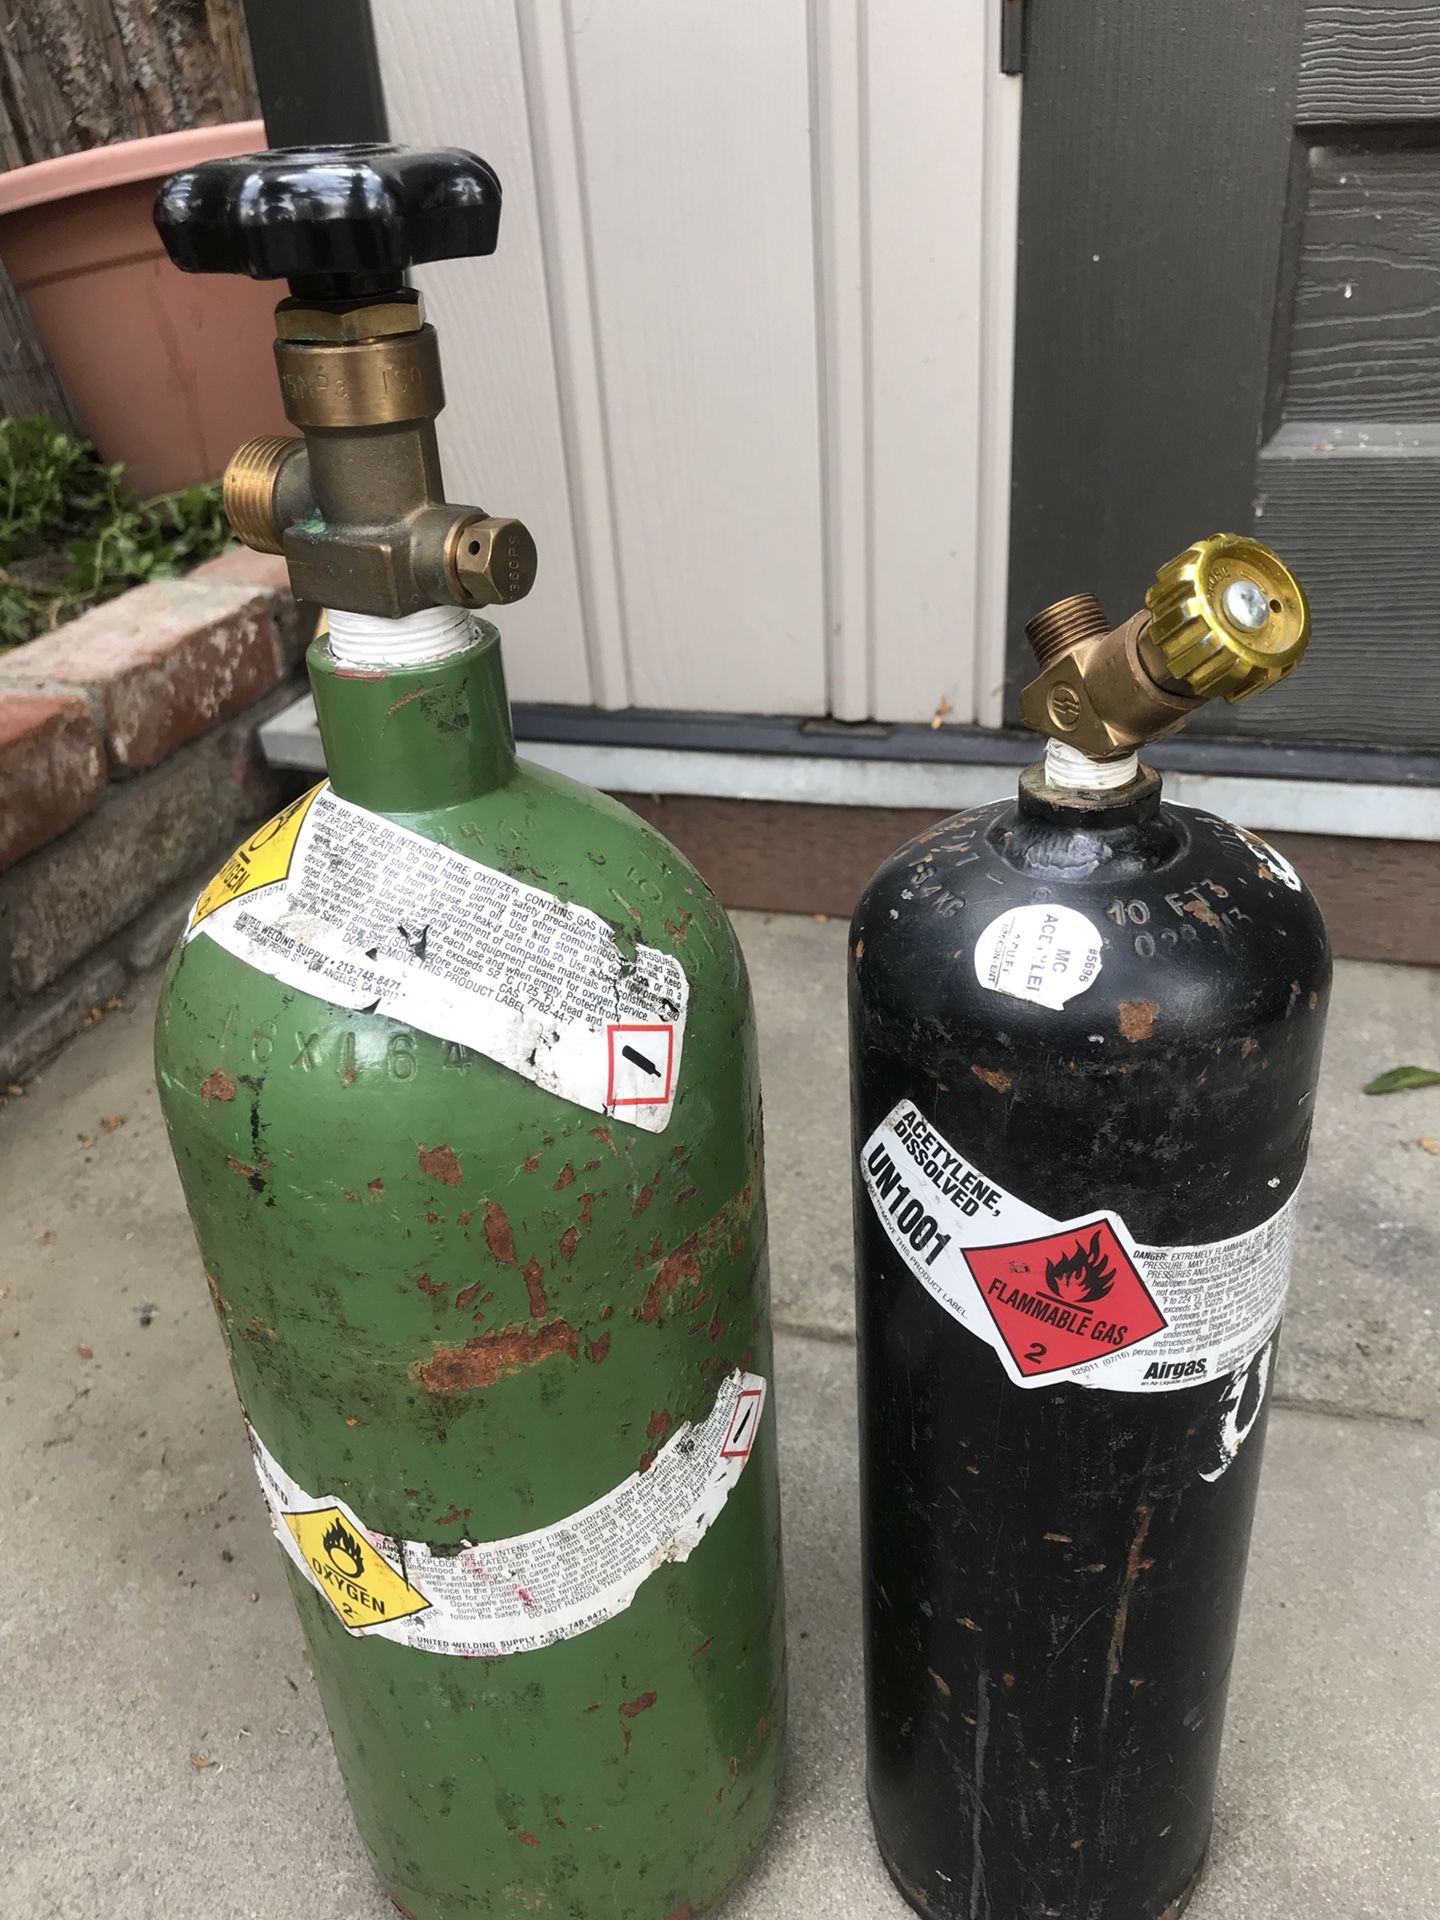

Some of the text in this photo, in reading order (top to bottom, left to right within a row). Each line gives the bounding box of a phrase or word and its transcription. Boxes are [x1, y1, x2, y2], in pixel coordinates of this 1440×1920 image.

[324, 813, 541, 918] EXPLODE IF Do not handle until all safety
[335, 806, 597, 931] MAY CAUSE OR INTENSIFY OXIDIZER. CONTAINS GAS
[369, 846, 557, 936] and store away from and other
[378, 886, 398, 902] Use
[491, 934, 504, 946] of
[503, 939, 557, 973] compatible
[556, 963, 600, 991] materials
[600, 983, 612, 995] of
[381, 863, 401, 879] free
[403, 873, 427, 891] from
[429, 886, 462, 908] grease
[507, 918, 528, 934] Use
[554, 939, 579, 957] store
[381, 876, 587, 973] In case of safe to do Use
[259, 924, 296, 949] WELDING
[295, 942, 330, 966] SUPPLY
[336, 955, 401, 996] 213-748-8471
[266, 940, 291, 958] PEDRO
[322, 966, 359, 989] ANGELES,
[360, 980, 374, 993] CA
[373, 983, 399, 1003] 90011
[318, 908, 346, 930] Safety
[497, 982, 521, 999] CAS
[525, 995, 575, 1025] 7782-44-7
[327, 900, 604, 1027] when exceeds Read and
[417, 957, 444, 978] THIS
[443, 969, 493, 1000] PRODUCT
[494, 991, 528, 1014] LABEL
[441, 933, 466, 951] each
[466, 946, 485, 961] use
[485, 954, 505, 970] and
[504, 963, 532, 982] when
[564, 990, 599, 1013] Protect
[451, 926, 475, 943] with
[473, 938, 526, 971] equipment
[526, 961, 565, 986] cleaned
[565, 979, 580, 992] for
[580, 986, 613, 1010] oxygen
[617, 1001, 651, 1023] service.
[1026, 914, 1059, 992] ACELE
[1052, 948, 1071, 973] MC
[1078, 948, 1098, 982] #5696
[894, 1121, 979, 1218] DISSOLVED
[903, 1111, 1002, 1217] ACETYLENE,
[868, 1143, 952, 1266] UN1001
[896, 1237, 910, 1258] THIS
[910, 1257, 944, 1293] PRODUCT
[1147, 1270, 1191, 1278] PRESSURES
[1171, 1250, 1213, 1261] EXTREMELY
[1188, 1260, 1204, 1268] MAY
[988, 1278, 1128, 1345] FLAMMABLE GAS
[1024, 1342, 1047, 1365] 2
[1071, 1351, 1130, 1376] 825011 (07/16)
[1132, 1347, 1158, 1357] person
[1159, 1348, 1167, 1356] to
[1168, 1344, 1185, 1355] fresh
[1143, 1358, 1207, 1379] Airgas
[311, 1556, 386, 1616] OXYGEN
[341, 1603, 355, 1619] 2
[417, 1637, 449, 1648] UNITED
[452, 1641, 496, 1649] WELDING
[500, 1635, 535, 1647] SUPPLY
[548, 1607, 608, 1637] 213-748-8471
